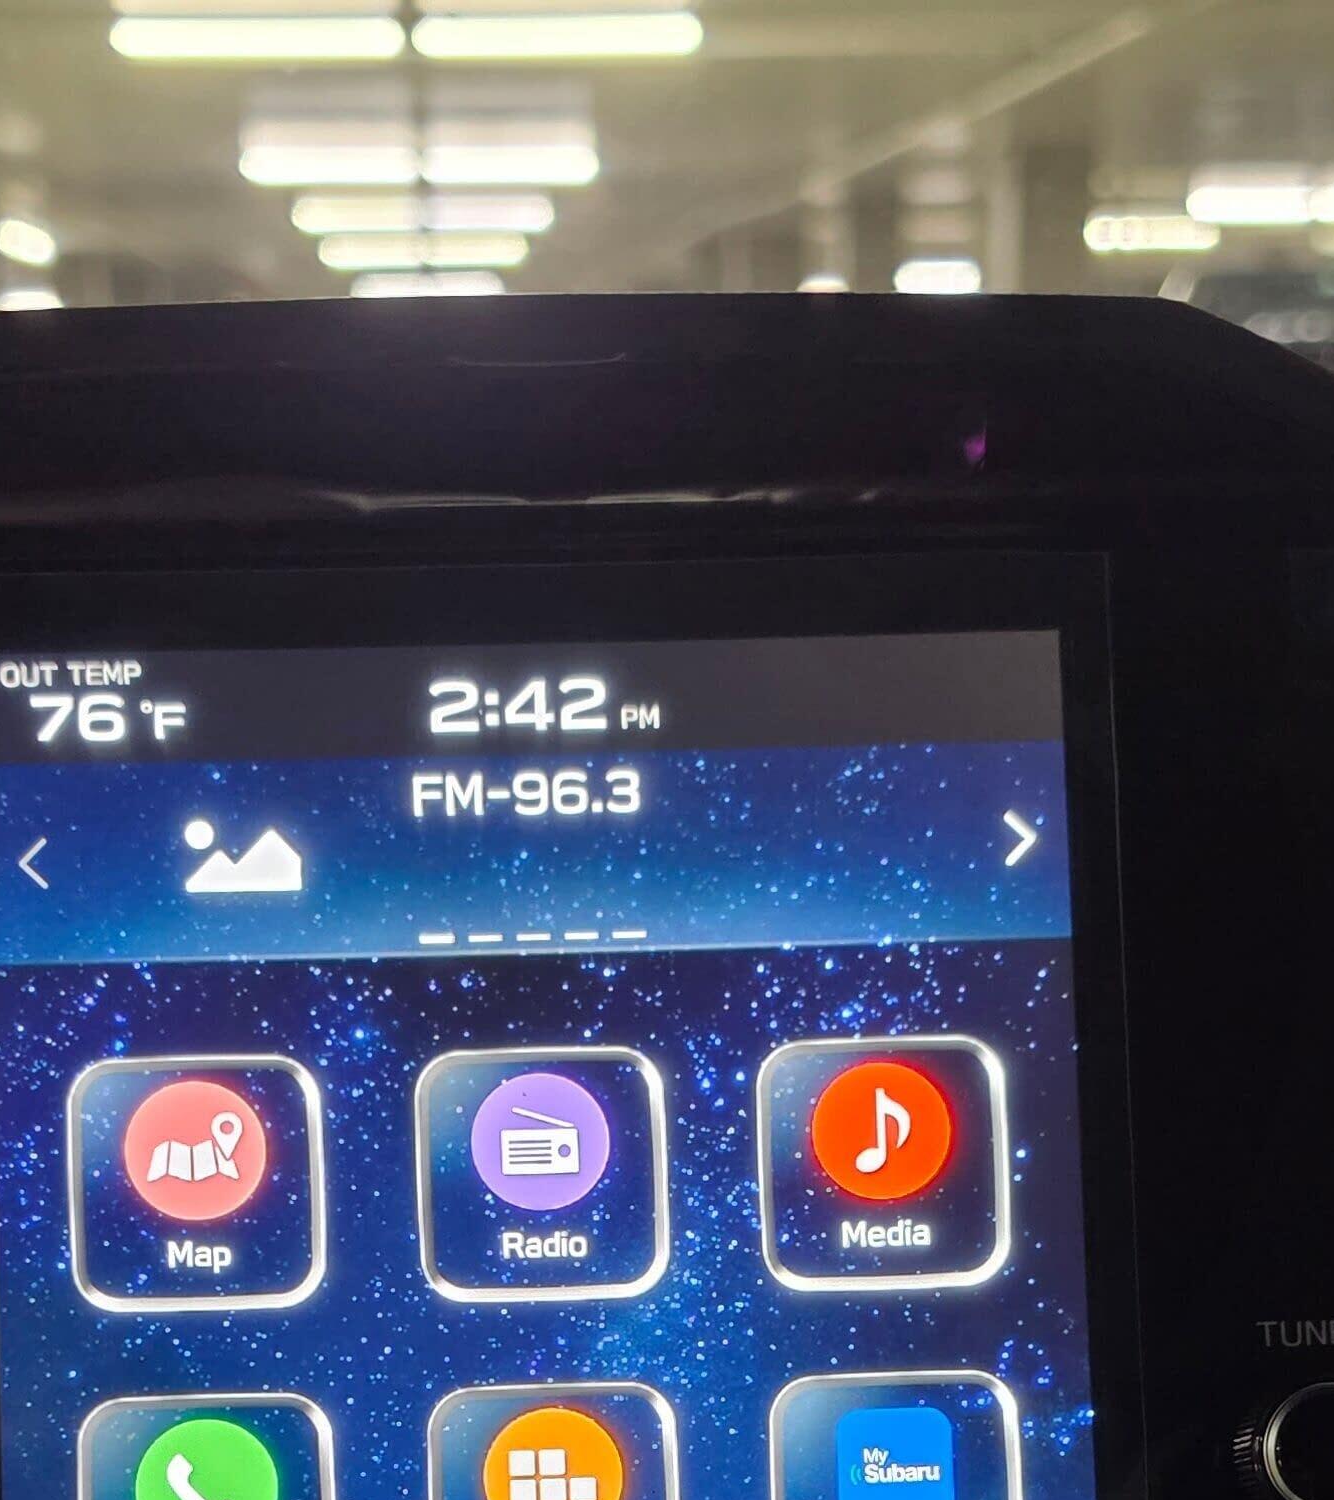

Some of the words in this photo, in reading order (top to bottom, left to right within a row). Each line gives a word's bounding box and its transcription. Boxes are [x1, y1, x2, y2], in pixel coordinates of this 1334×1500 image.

[0, 661, 59, 689] OUT
[66, 659, 143, 687] TEMP
[28, 692, 126, 743] 76
[427, 676, 609, 735] 2:42
[620, 702, 662, 731] PM
[411, 768, 642, 818] FM-96.3
[501, 1229, 588, 1262] Radio
[840, 1218, 933, 1250] Media
[166, 1239, 233, 1275] Map
[862, 1447, 890, 1466] My
[864, 1463, 941, 1484] Subaru
